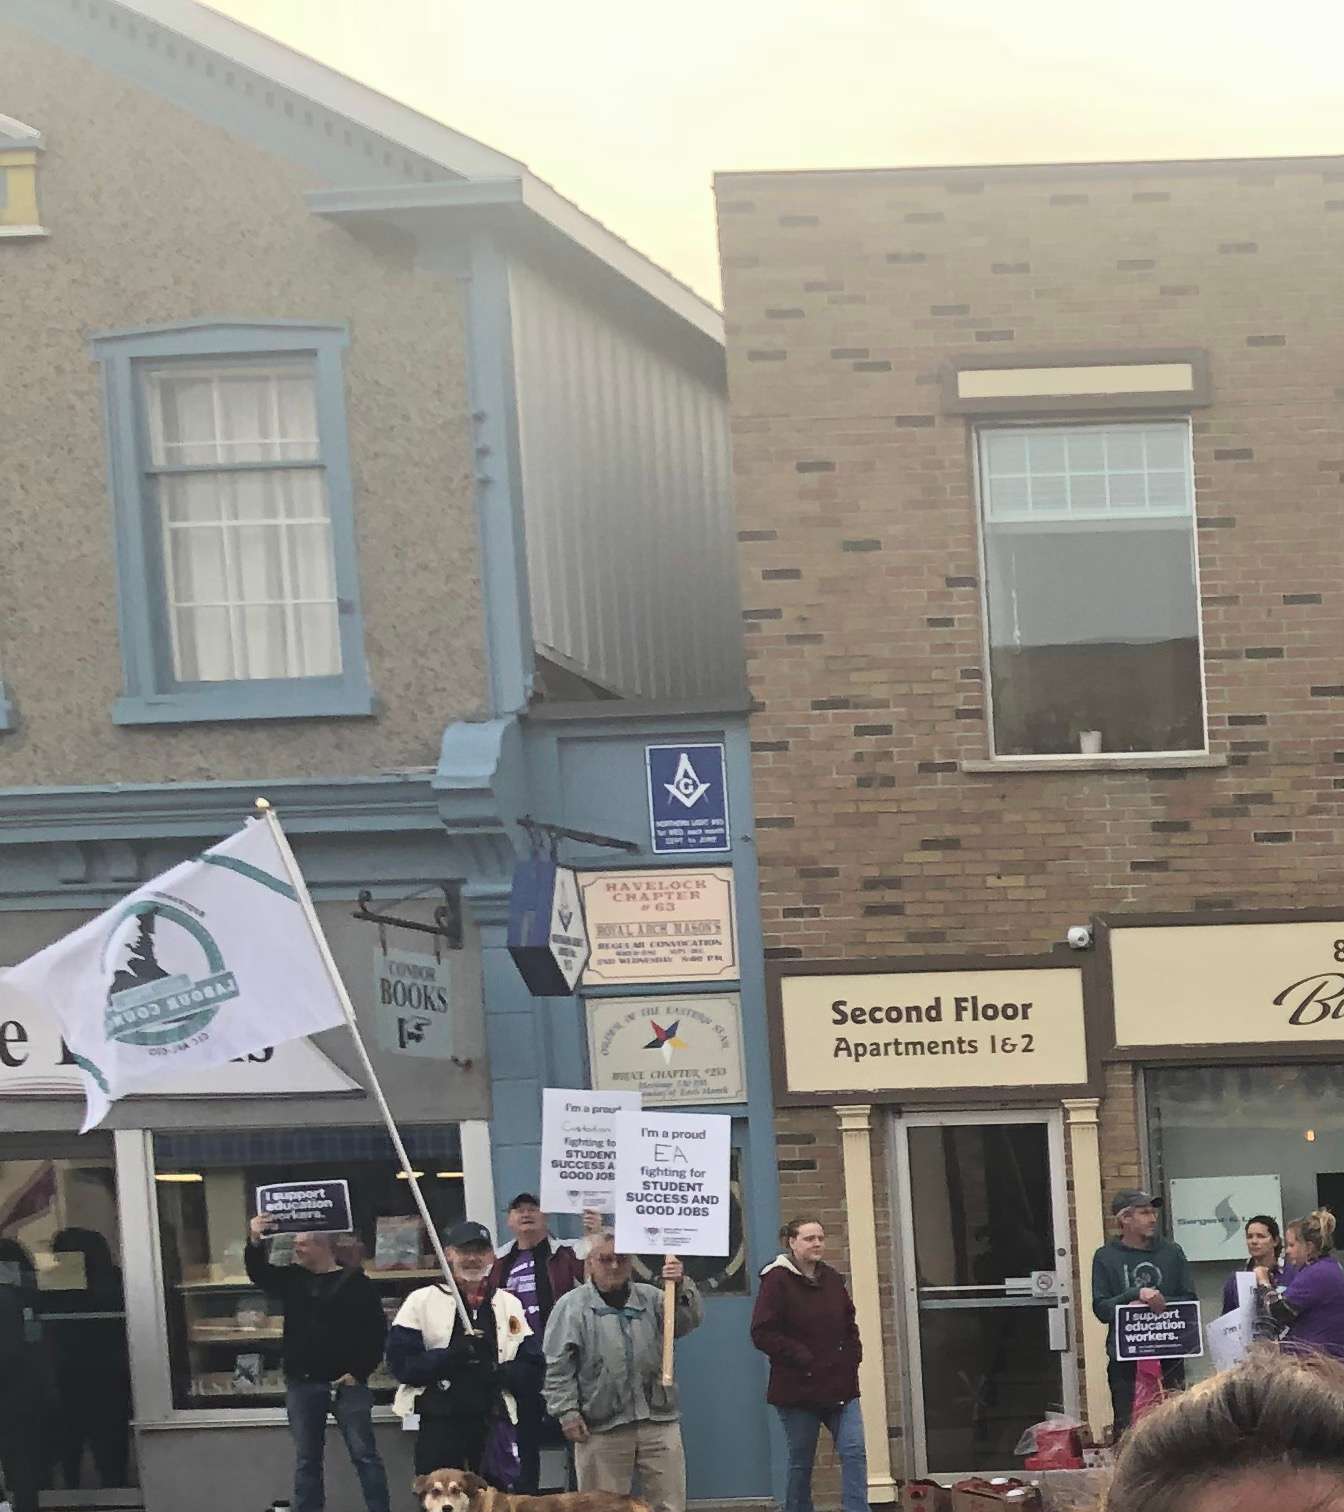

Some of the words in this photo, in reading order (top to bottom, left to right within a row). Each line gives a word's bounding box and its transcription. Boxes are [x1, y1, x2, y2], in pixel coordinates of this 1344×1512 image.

[606, 879, 707, 892] HAVELOCK
[612, 891, 702, 901] CHAPTER
[654, 902, 676, 912] 63
[380, 977, 448, 1013] BOOKS
[832, 997, 942, 1025] Second
[954, 996, 1033, 1022] Floor
[833, 1035, 978, 1062] Apartments
[641, 1128, 659, 1138] I'm
[672, 1130, 706, 1140] proud
[654, 1144, 688, 1164] EA
[640, 1166, 687, 1178] fighting
[690, 1167, 707, 1177] for
[642, 1181, 704, 1192] STUDENT
[626, 1192, 688, 1204] SUCCESS
[692, 1194, 719, 1204] AND
[636, 1205, 674, 1216] GOOD
[678, 1206, 709, 1216] JOBS
[1126, 1312, 1130, 1320] I
[1132, 1309, 1180, 1320] support
[1125, 1320, 1185, 1332] education
[1125, 1331, 1178, 1342] workers.
